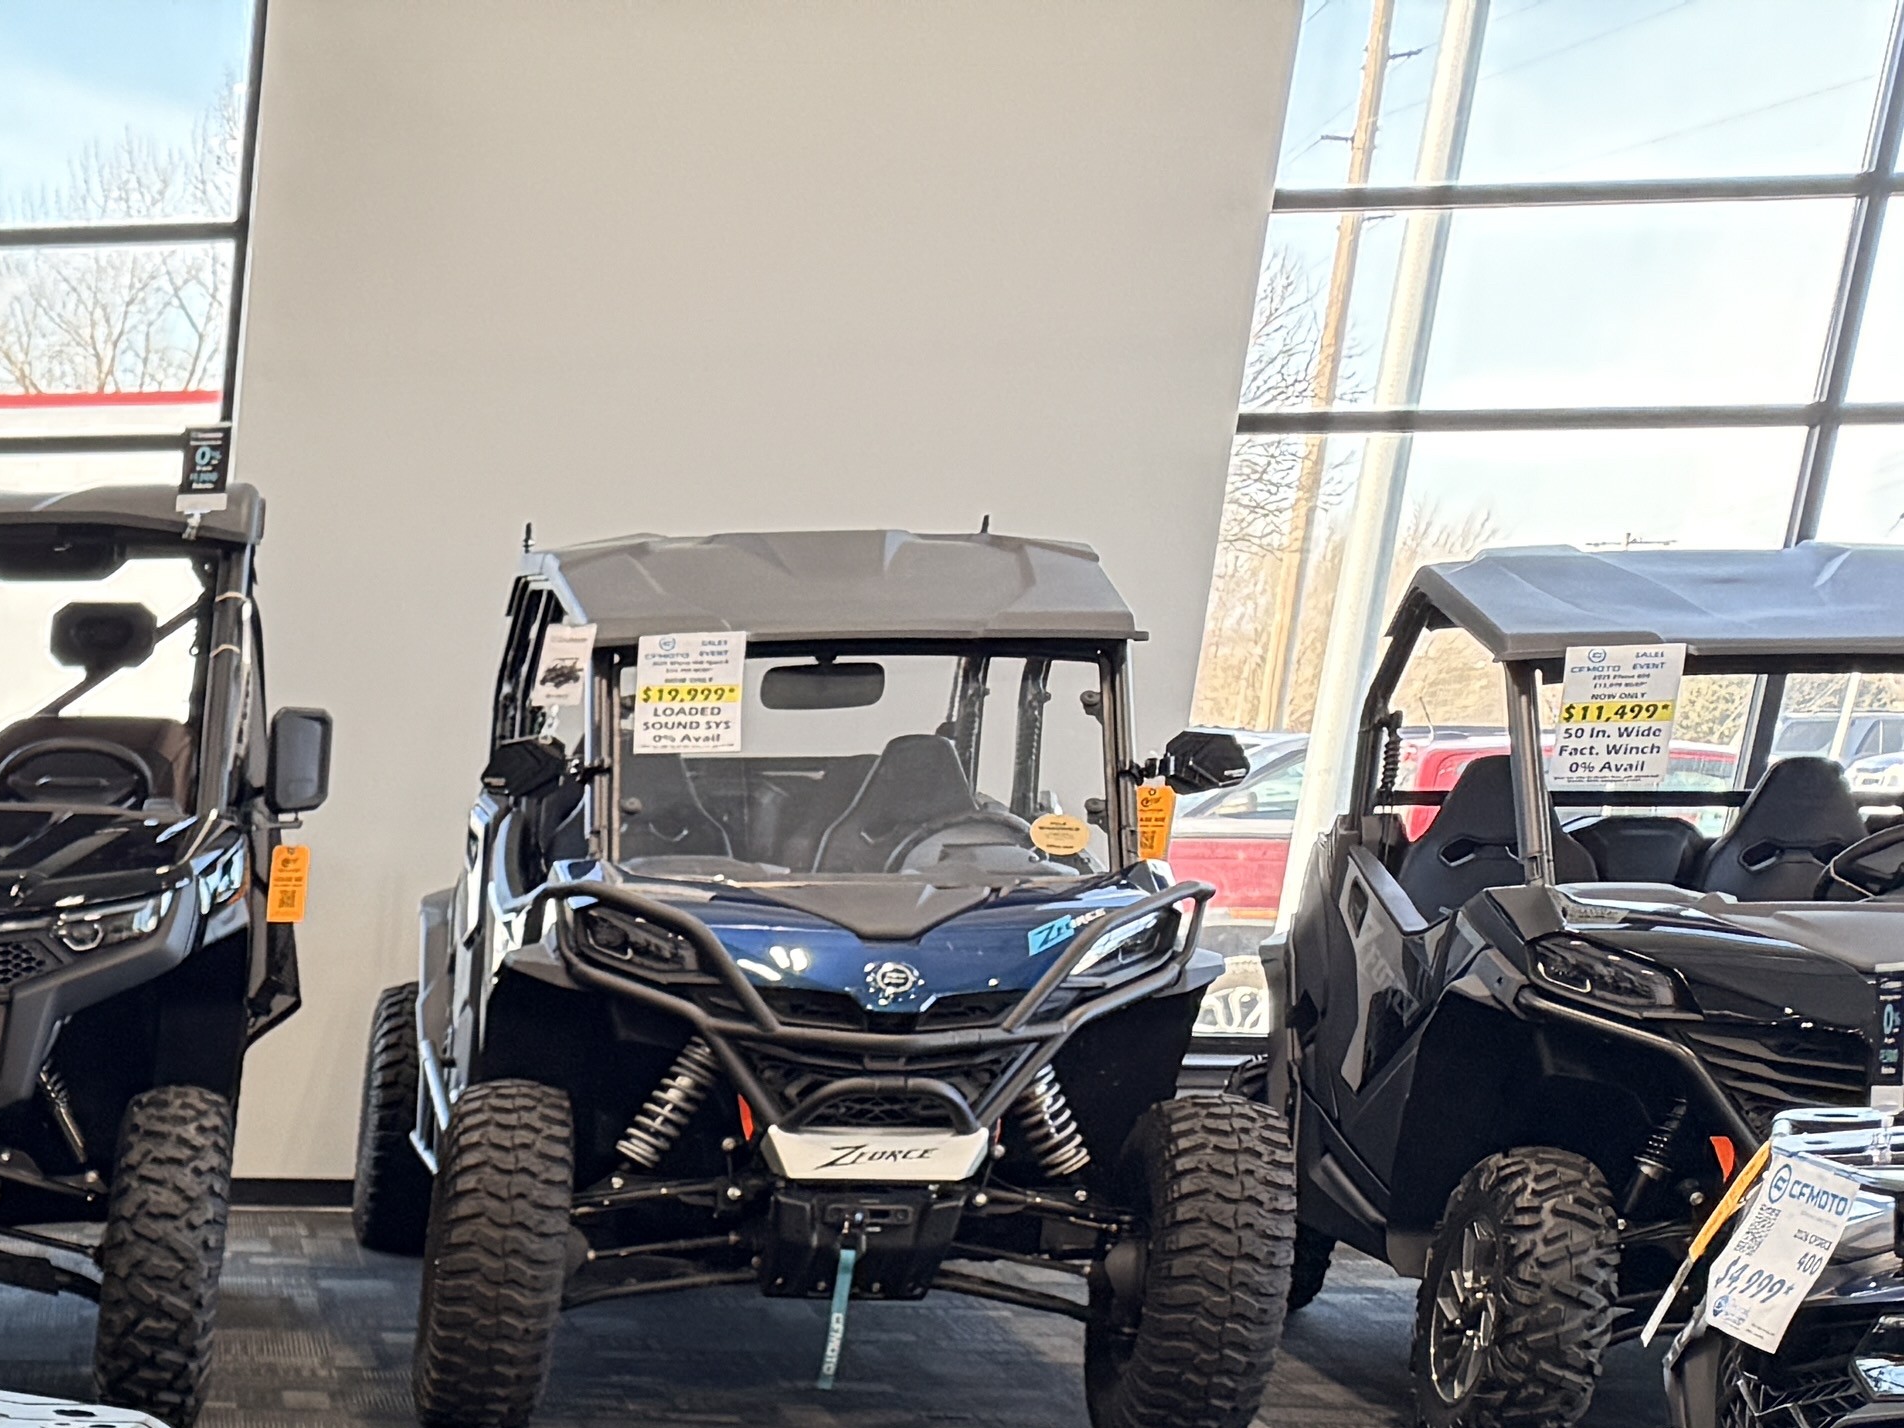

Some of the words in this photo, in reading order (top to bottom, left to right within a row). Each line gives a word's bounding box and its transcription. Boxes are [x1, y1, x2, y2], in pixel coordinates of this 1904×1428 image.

[1632, 662, 1666, 670] EVENT
[653, 707, 721, 717] LOADED
[643, 721, 700, 730] SOUND
[705, 721, 731, 730] SYS
[680, 734, 720, 742] Avail
[1563, 728, 1584, 739] 50
[1590, 727, 1610, 738] In.
[1617, 727, 1662, 738] Wide
[1559, 746, 1599, 756] Fact.
[1606, 744, 1660, 755] Winch
[1569, 762, 1594, 772] 0%
[1599, 761, 1644, 772] Avail
[813, 1144, 939, 1171] ZFORCE
[1789, 1180, 1848, 1216] CFMOTO
[1797, 1252, 1823, 1276] 400
